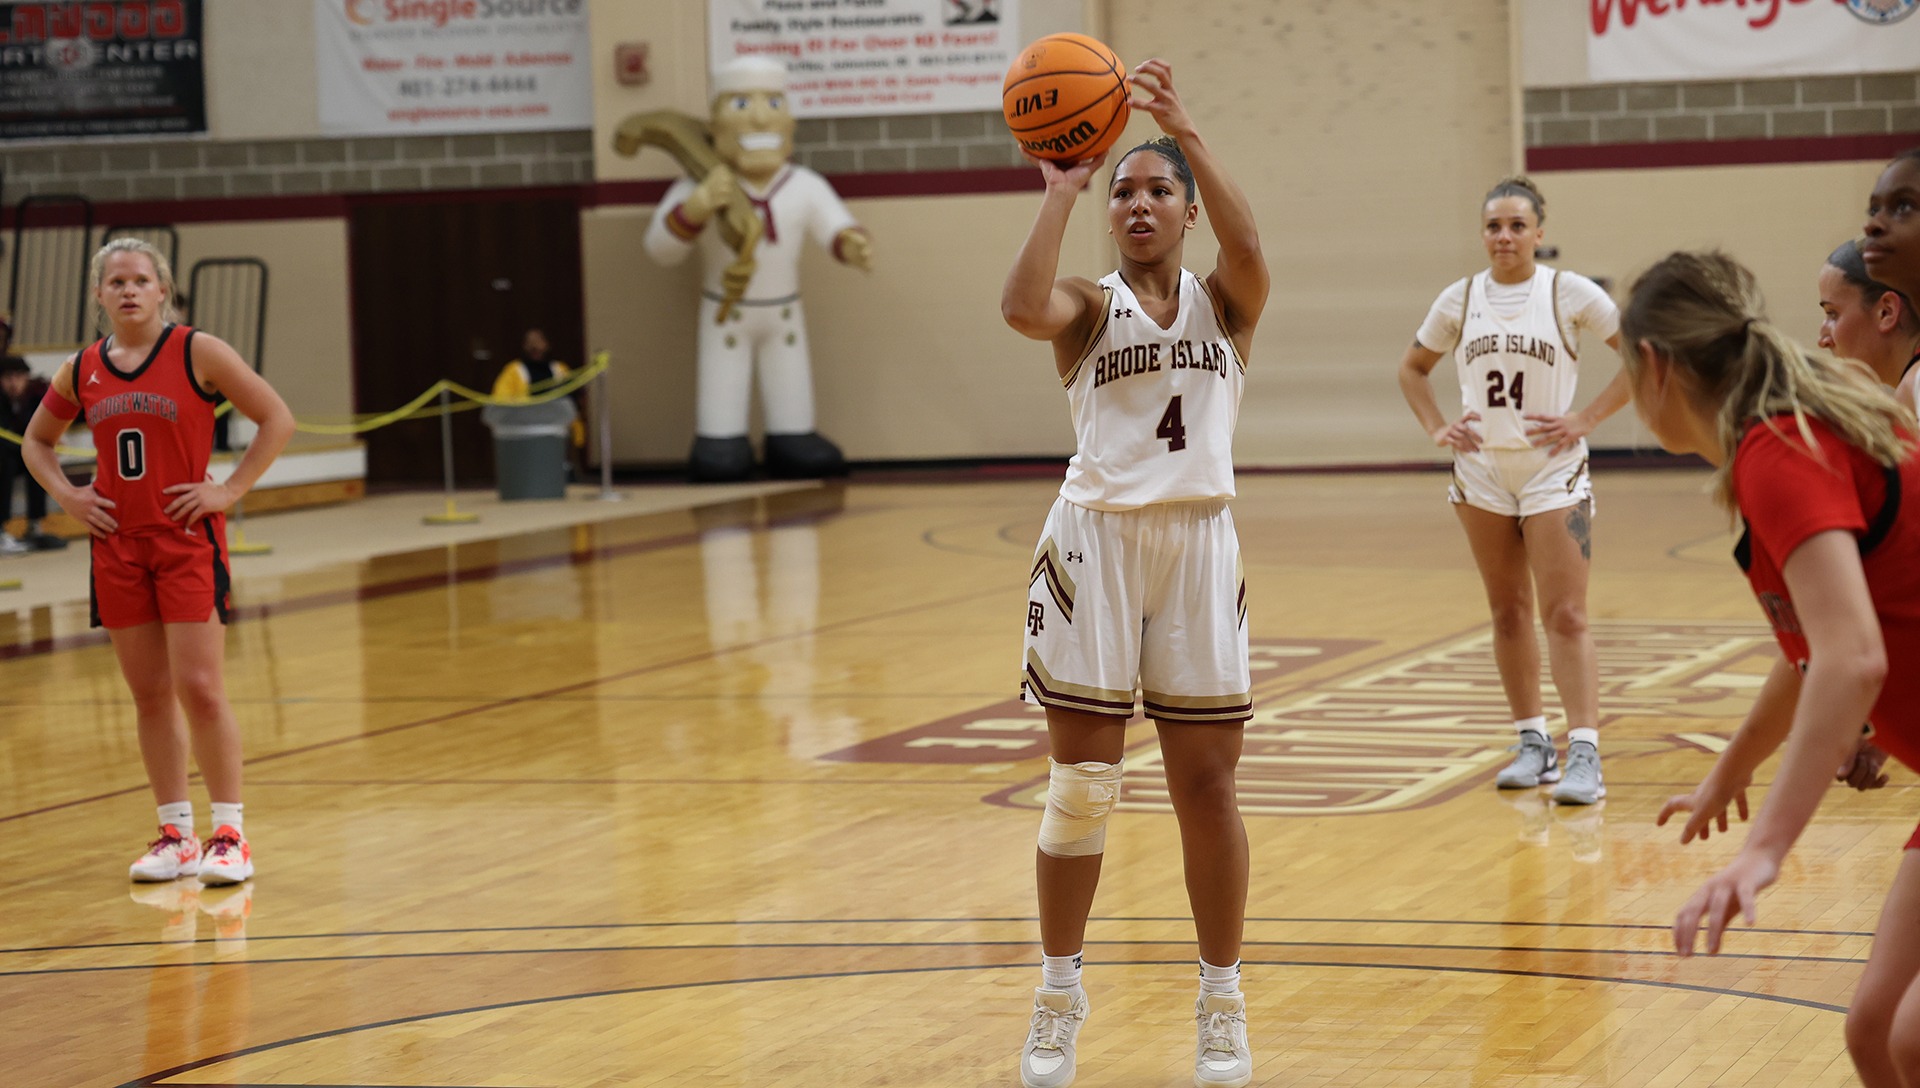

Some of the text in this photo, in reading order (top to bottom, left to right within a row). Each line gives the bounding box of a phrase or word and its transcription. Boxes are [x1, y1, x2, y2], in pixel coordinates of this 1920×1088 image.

[0, 1, 186, 42] MWOOD
[384, 0, 581, 27] SingleSource
[731, 14, 924, 33] Family Style Restaurants
[361, 56, 403, 71] Water
[414, 54, 445, 69] Fire
[454, 53, 493, 69] Mold
[735, 40, 801, 58] Serving
[830, 36, 858, 51] For
[864, 34, 907, 51] Over
[1015, 88, 1058, 117] EVO
[1019, 119, 1099, 154] Wilson
[1093, 339, 1228, 389] RHODE ISLAND
[1465, 334, 1556, 367] RHODE ISLAND
[1486, 370, 1525, 411] 24
[88, 391, 178, 425] BRIDGEWATER
[1156, 394, 1187, 453] 4
[116, 428, 146, 481] 0
